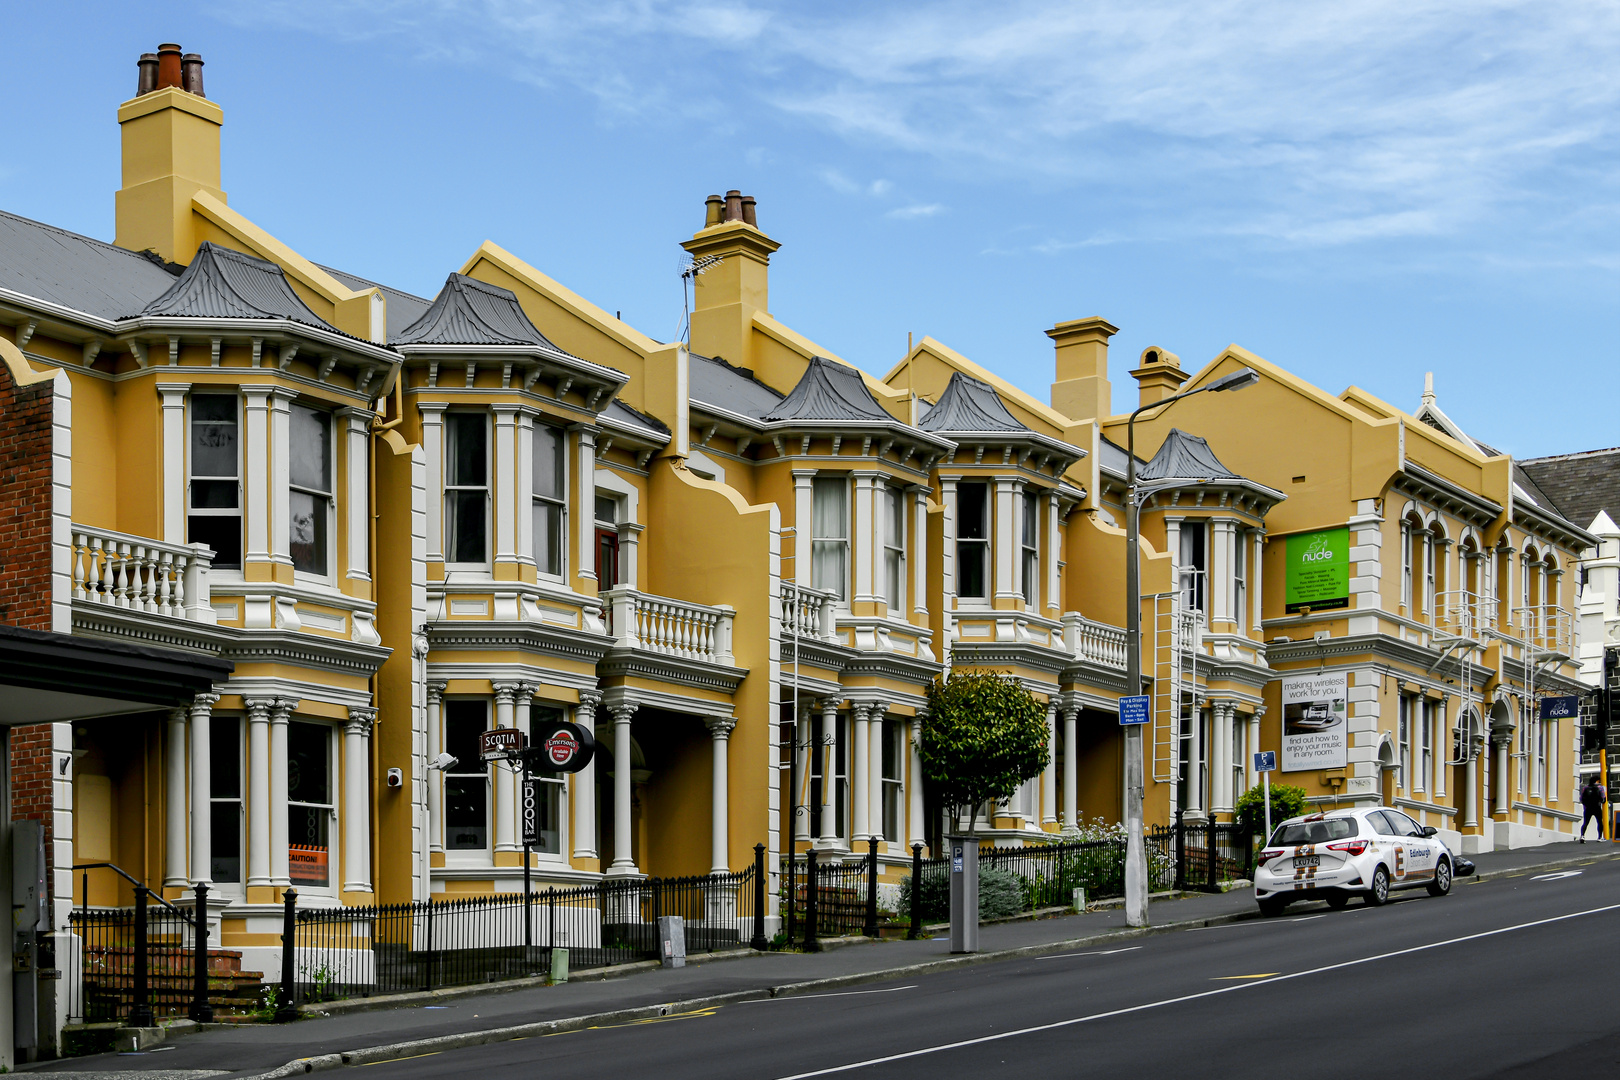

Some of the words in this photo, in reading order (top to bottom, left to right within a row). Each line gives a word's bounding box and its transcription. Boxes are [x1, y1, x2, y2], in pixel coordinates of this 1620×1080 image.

[1302, 548, 1333, 562] nude
[1284, 681, 1313, 691] making
[1314, 678, 1345, 687] wireless
[1289, 689, 1309, 698] work
[1310, 688, 1321, 696] for
[1322, 687, 1339, 697] you.
[1549, 706, 1569, 716] nude
[485, 733, 516, 747] SCOTIA
[1289, 737, 1302, 745] find
[1302, 736, 1314, 744] out
[1315, 735, 1331, 743] how
[1286, 744, 1304, 753] enjoy
[1304, 743, 1320, 751] your
[1321, 741, 1342, 749] music
[1301, 750, 1313, 758] any
[524, 787, 535, 830] DOON
[955, 847, 962, 857] P
[1409, 848, 1431, 859] Edinburgh
[1294, 857, 1319, 867] LKU742
[1394, 846, 1405, 877] E
